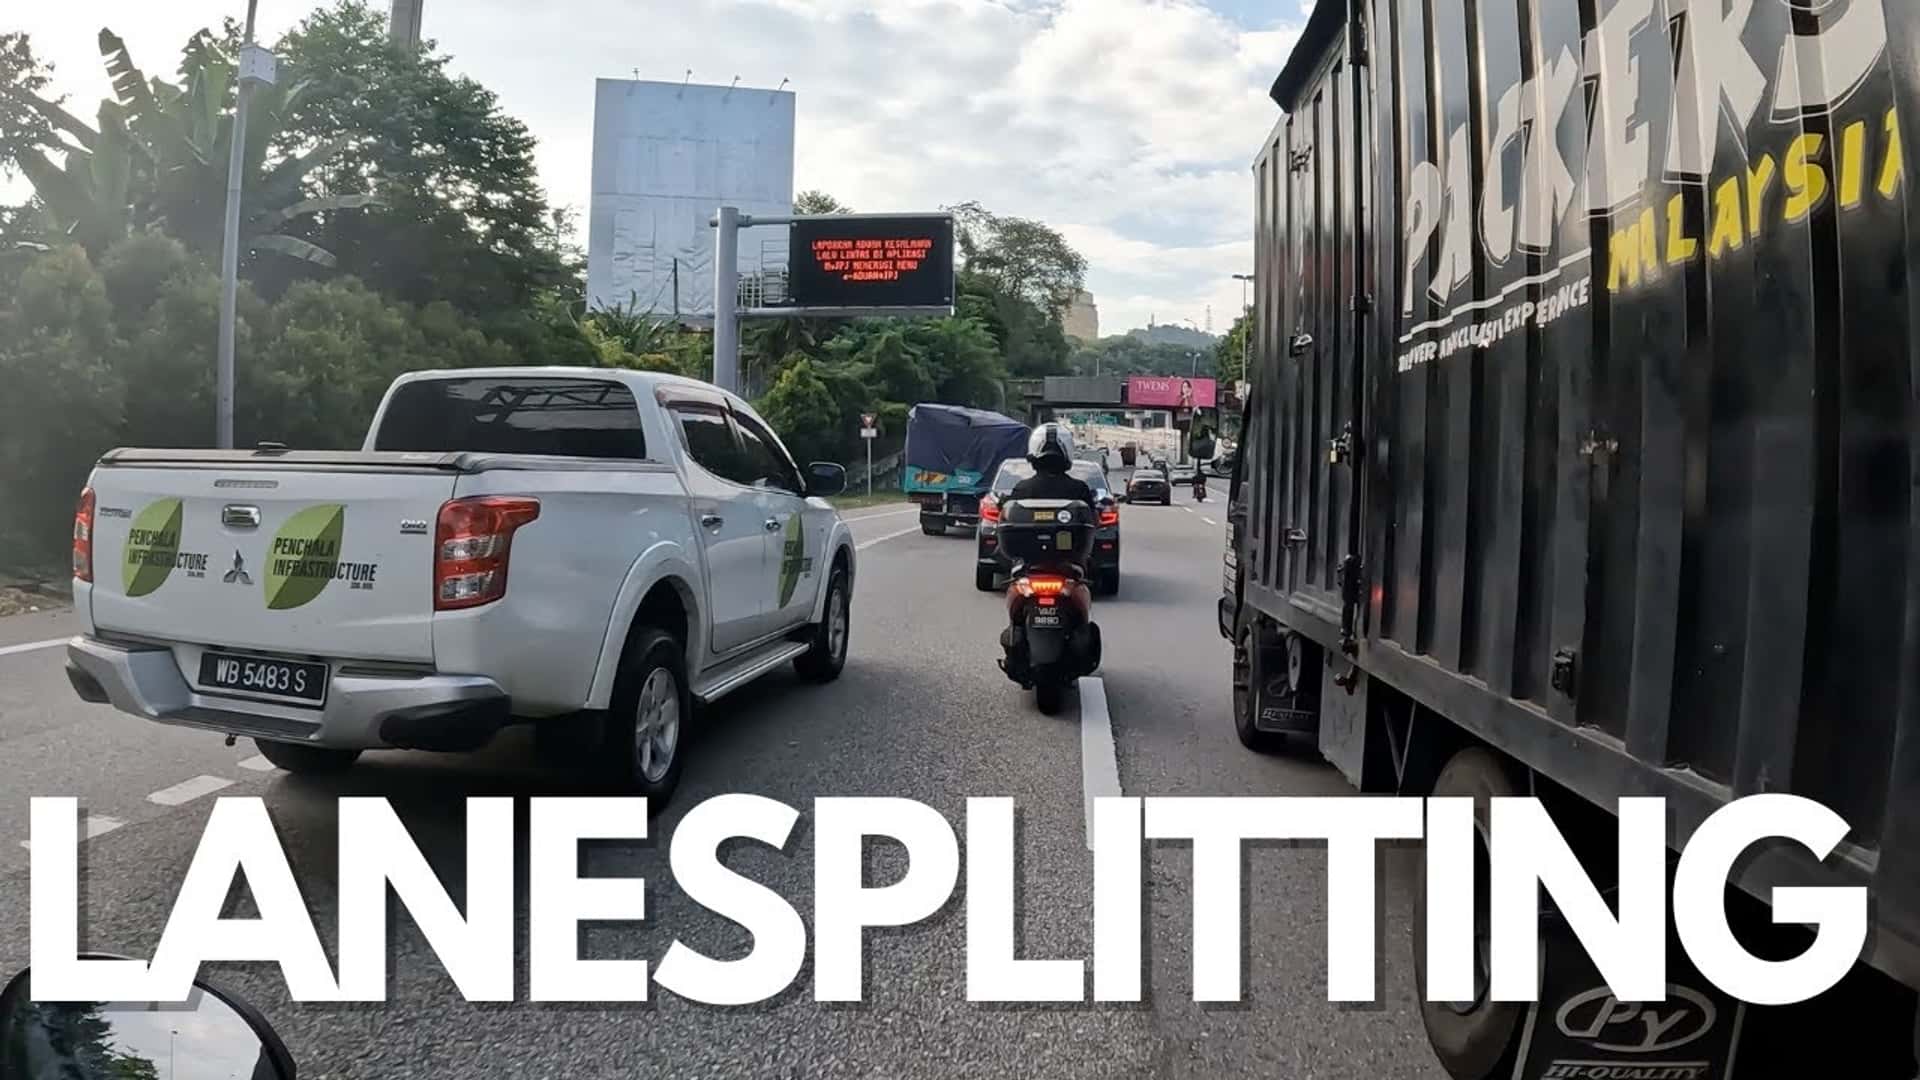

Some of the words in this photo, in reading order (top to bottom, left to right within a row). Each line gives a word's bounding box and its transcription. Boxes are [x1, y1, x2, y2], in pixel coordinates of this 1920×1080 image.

[129, 528, 177, 547] PENCHALA
[273, 537, 335, 557] PENCHALA
[128, 548, 208, 570] INFRASTRUCTURE
[272, 558, 378, 582] INFRASTRUCTURE
[216, 658, 240, 684] WB
[243, 662, 291, 690] 5483
[293, 668, 308, 693] S
[1543, 1065, 1704, 1080] HI-QUALITY
